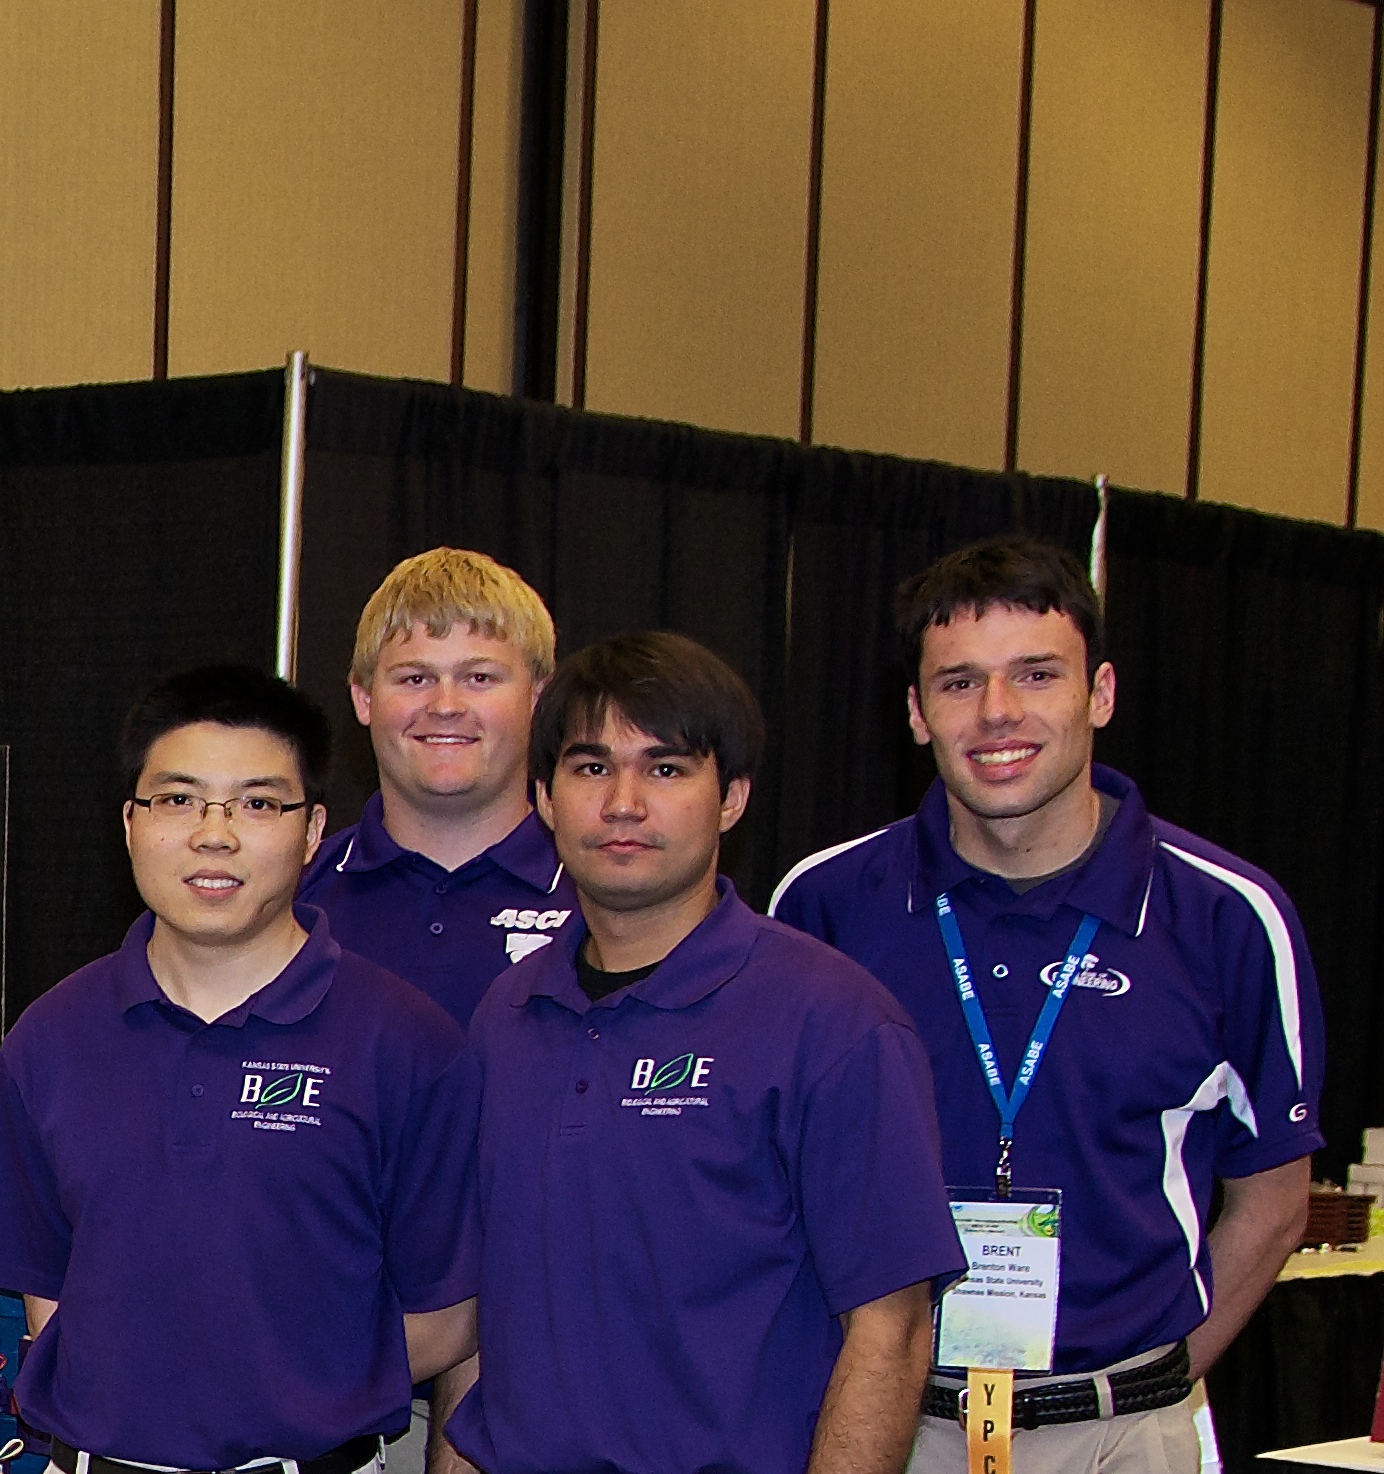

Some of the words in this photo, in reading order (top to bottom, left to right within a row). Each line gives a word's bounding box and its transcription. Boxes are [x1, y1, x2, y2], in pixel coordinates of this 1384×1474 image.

[953, 958, 975, 1001] ASABE
[1052, 954, 1081, 999] ASABE
[977, 1043, 1001, 1086] ASABE
[1019, 1040, 1044, 1086] ASABE
[972, 1262, 1005, 1271] Brenton
[982, 1245, 1021, 1256] BRENT
